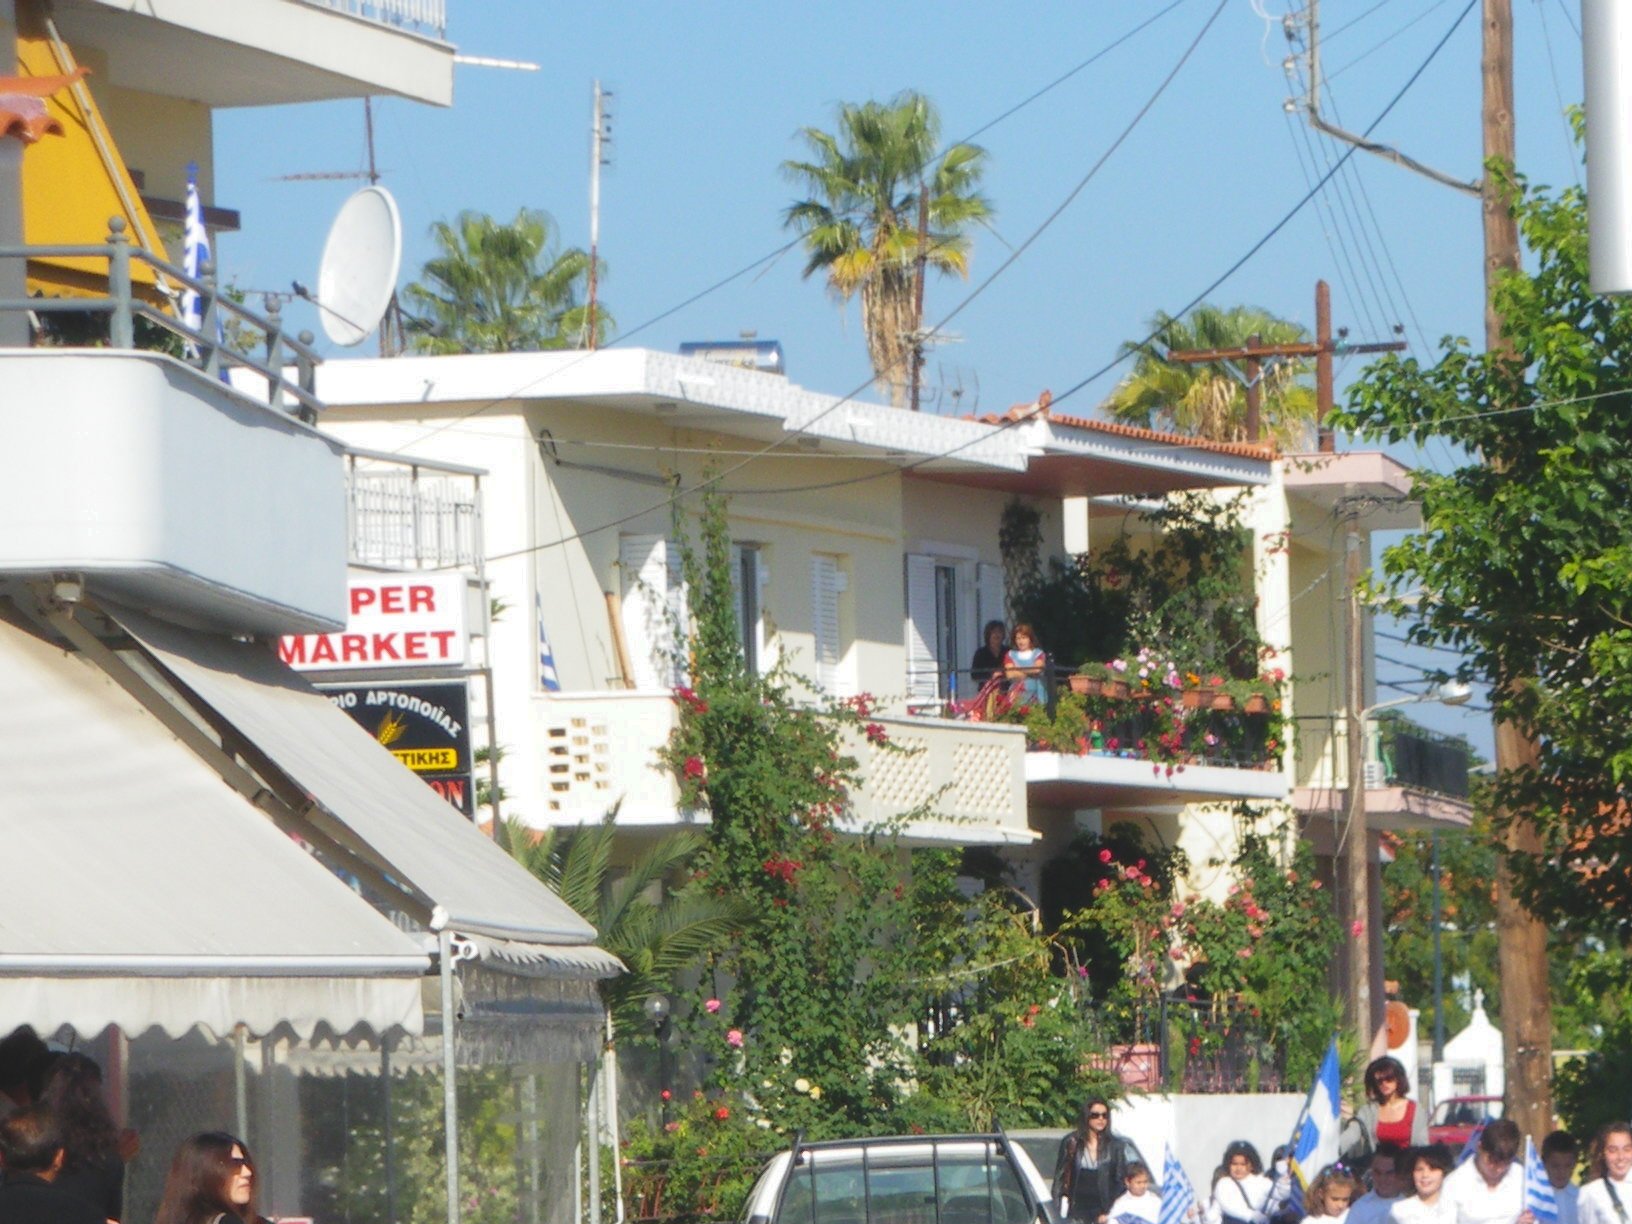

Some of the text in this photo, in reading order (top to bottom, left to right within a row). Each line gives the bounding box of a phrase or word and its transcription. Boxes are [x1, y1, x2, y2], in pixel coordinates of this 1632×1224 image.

[350, 586, 436, 615] PER
[278, 631, 456, 665] MARKET
[394, 752, 450, 766] ΤΙΚΗΣ
